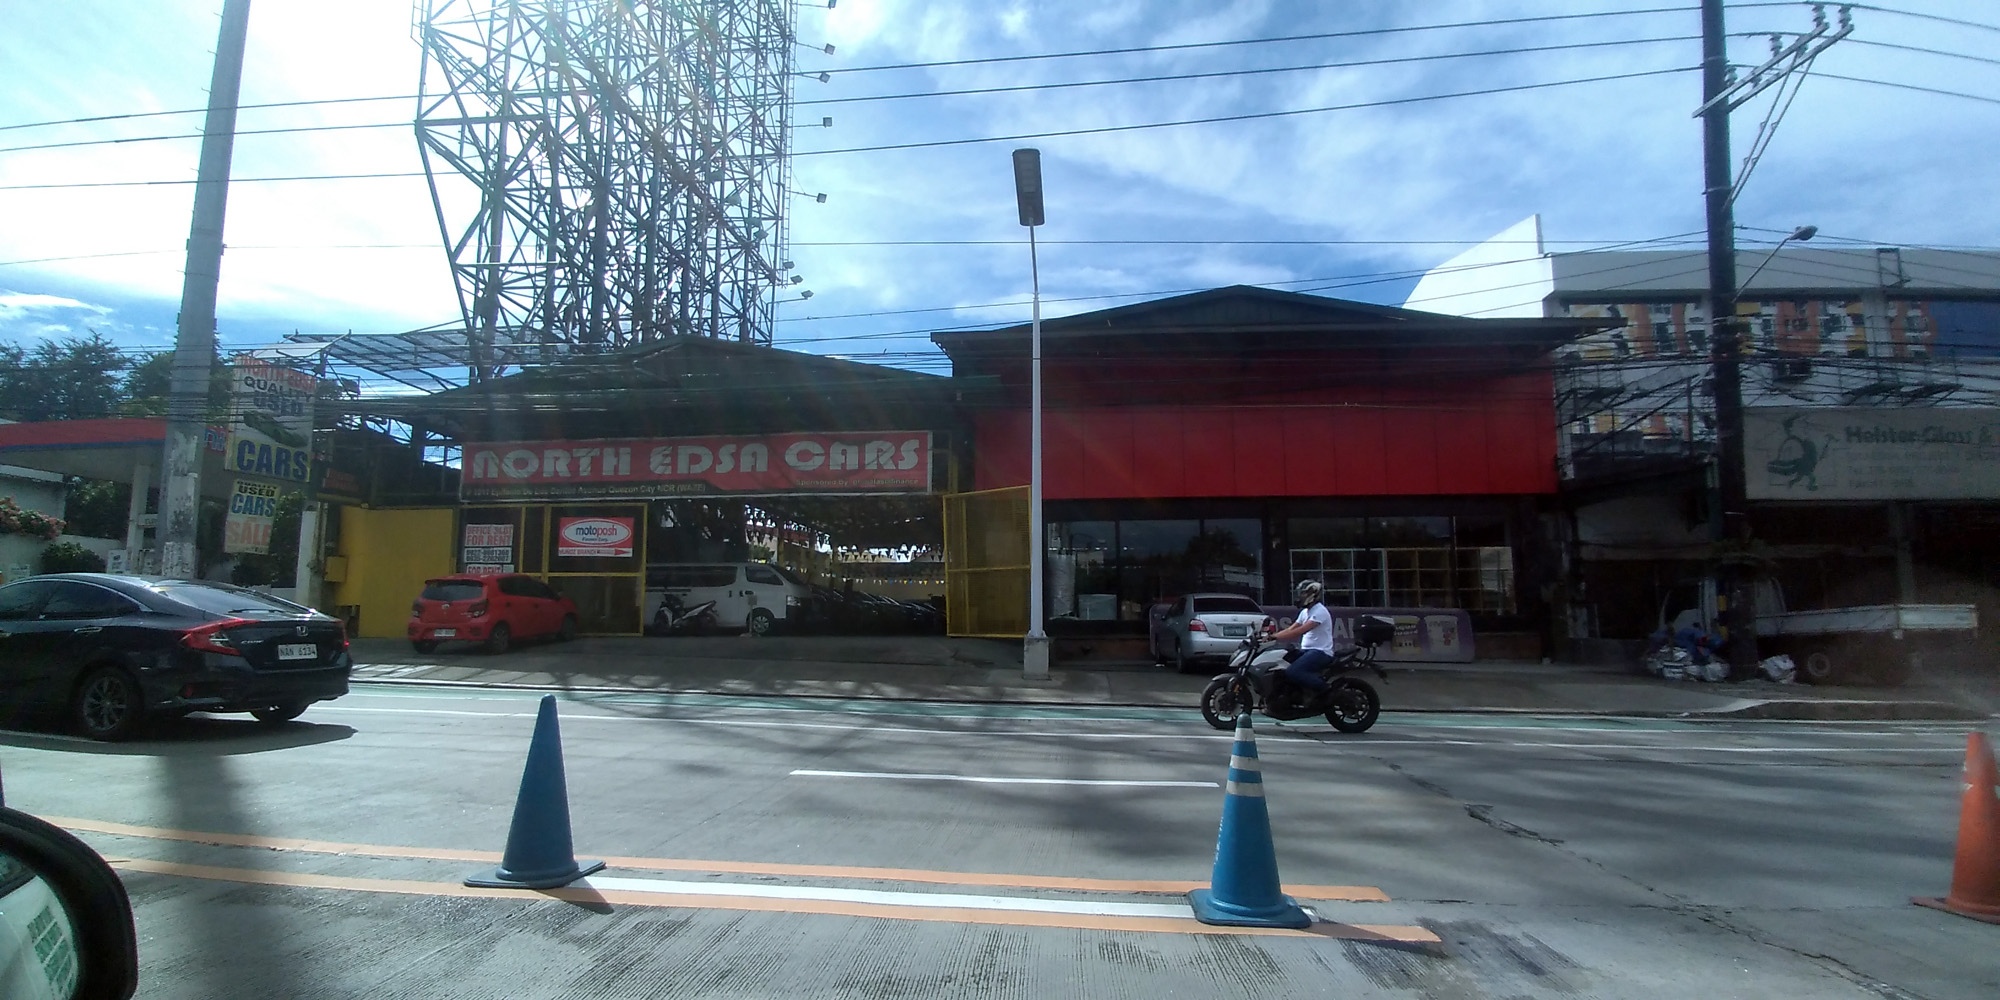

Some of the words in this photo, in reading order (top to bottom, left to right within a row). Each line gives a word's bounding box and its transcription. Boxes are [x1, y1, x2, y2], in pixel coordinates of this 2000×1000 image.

[244, 375, 312, 403] QUALITY
[236, 440, 309, 482] CARS
[472, 447, 631, 479] NORTH
[649, 443, 768, 476] EDSA
[783, 439, 920, 471] CARS
[239, 485, 275, 497] USED
[608, 485, 638, 494] Quezon
[640, 484, 656, 495] City
[657, 484, 676, 493] NCR
[232, 493, 276, 517] CARS
[227, 521, 273, 546] SALE
[467, 535, 484, 546] FOR
[487, 534, 511, 546] RENT
[575, 525, 617, 537] motoposh
